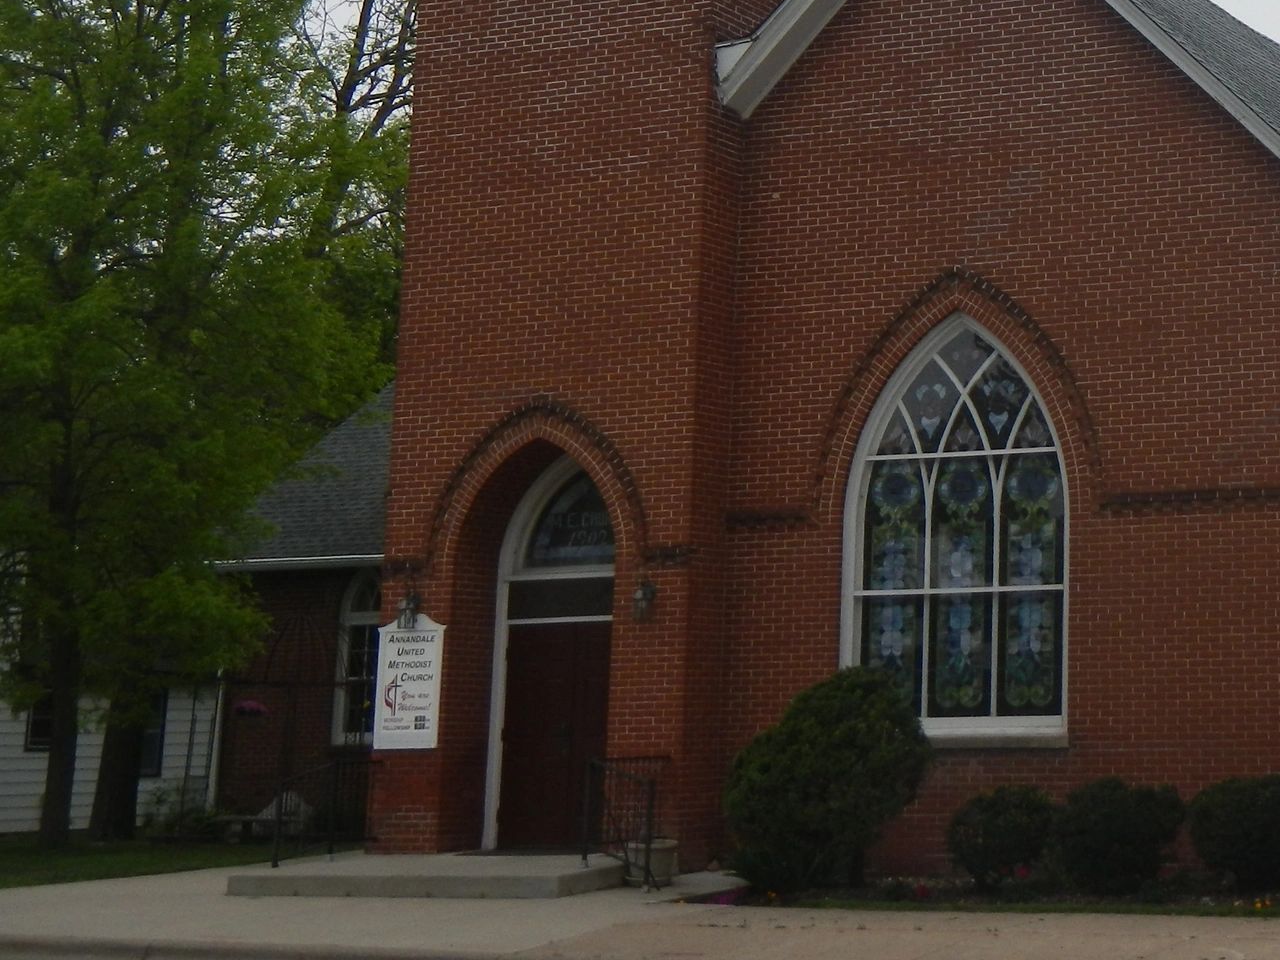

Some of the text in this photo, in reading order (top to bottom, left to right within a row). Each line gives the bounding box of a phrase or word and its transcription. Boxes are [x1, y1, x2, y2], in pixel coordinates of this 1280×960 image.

[388, 634, 436, 644] ANNANDALE
[397, 647, 425, 656] UNITED
[388, 660, 432, 669] METHODIST
[400, 673, 433, 682] CHURCH
